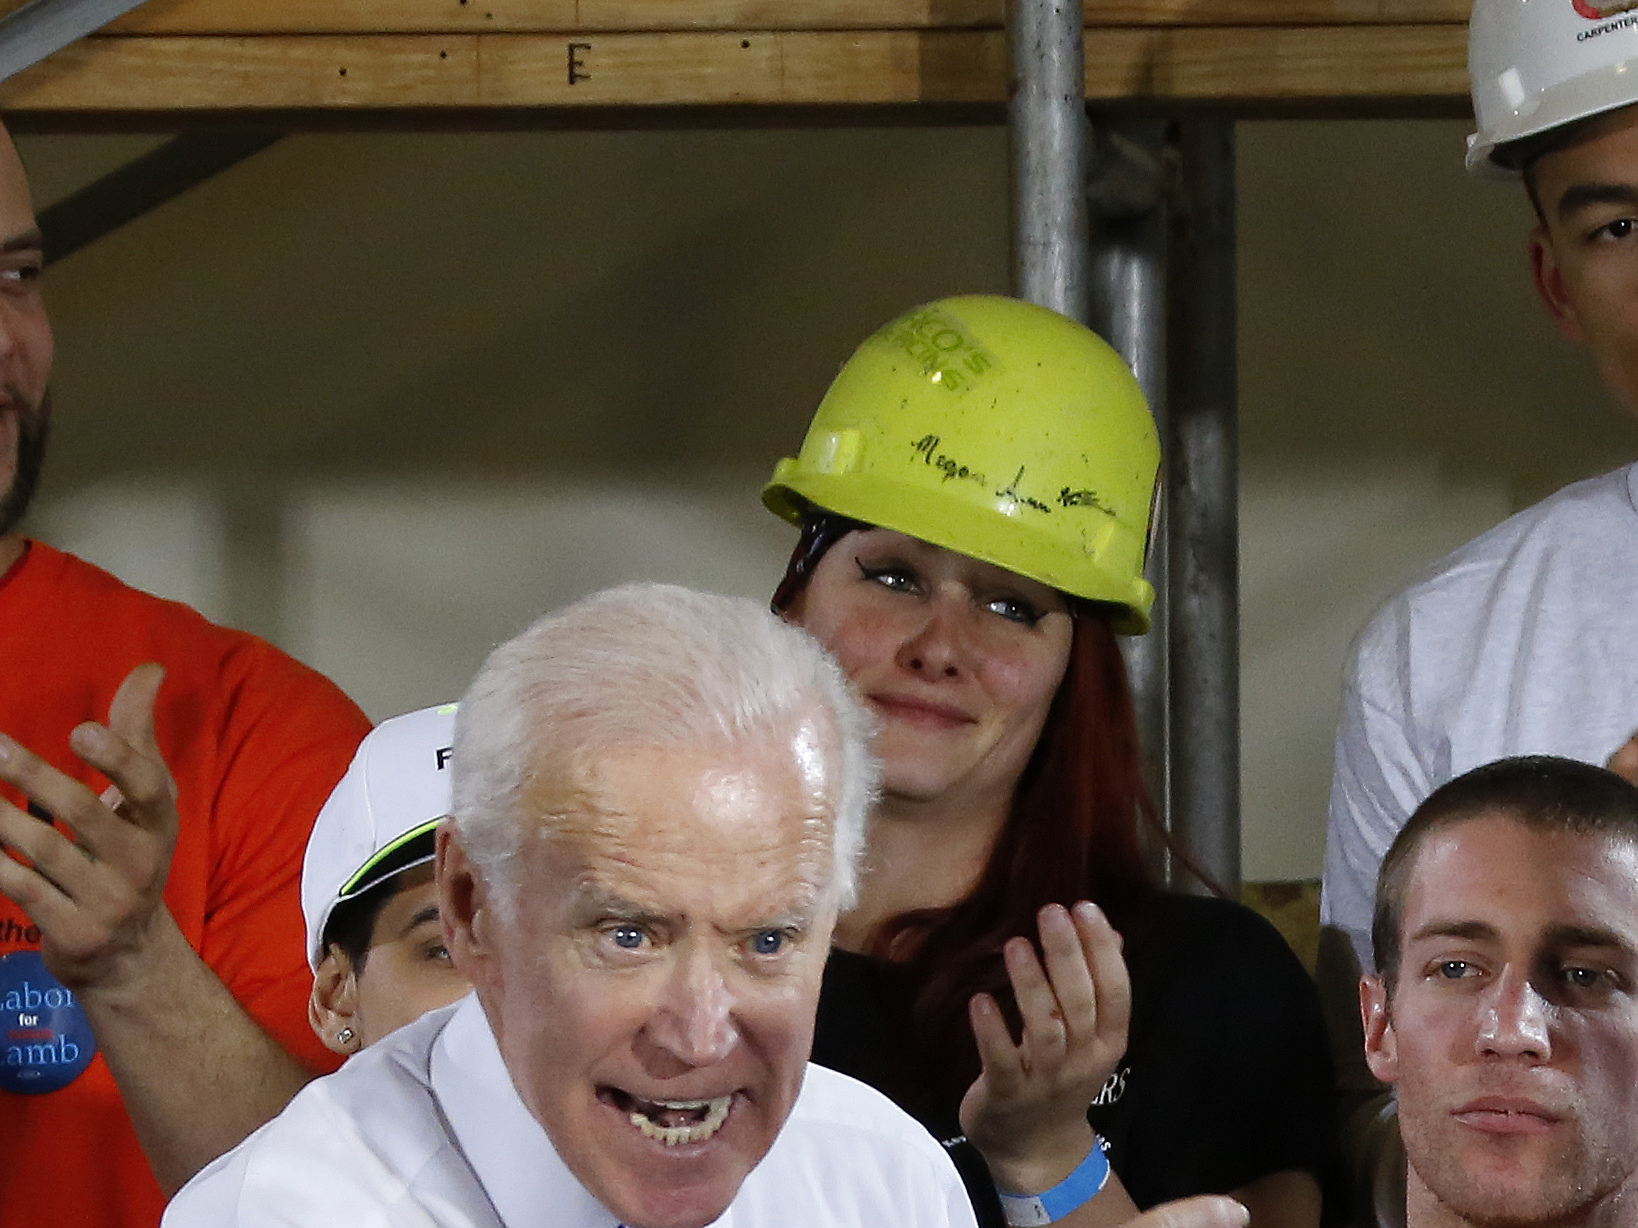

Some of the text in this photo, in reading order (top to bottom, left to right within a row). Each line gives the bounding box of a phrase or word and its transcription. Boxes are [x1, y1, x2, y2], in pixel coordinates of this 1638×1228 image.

[567, 42, 592, 86] E
[0, 981, 74, 1010] abor
[18, 1012, 39, 1026] for
[6, 1033, 79, 1066] amb
